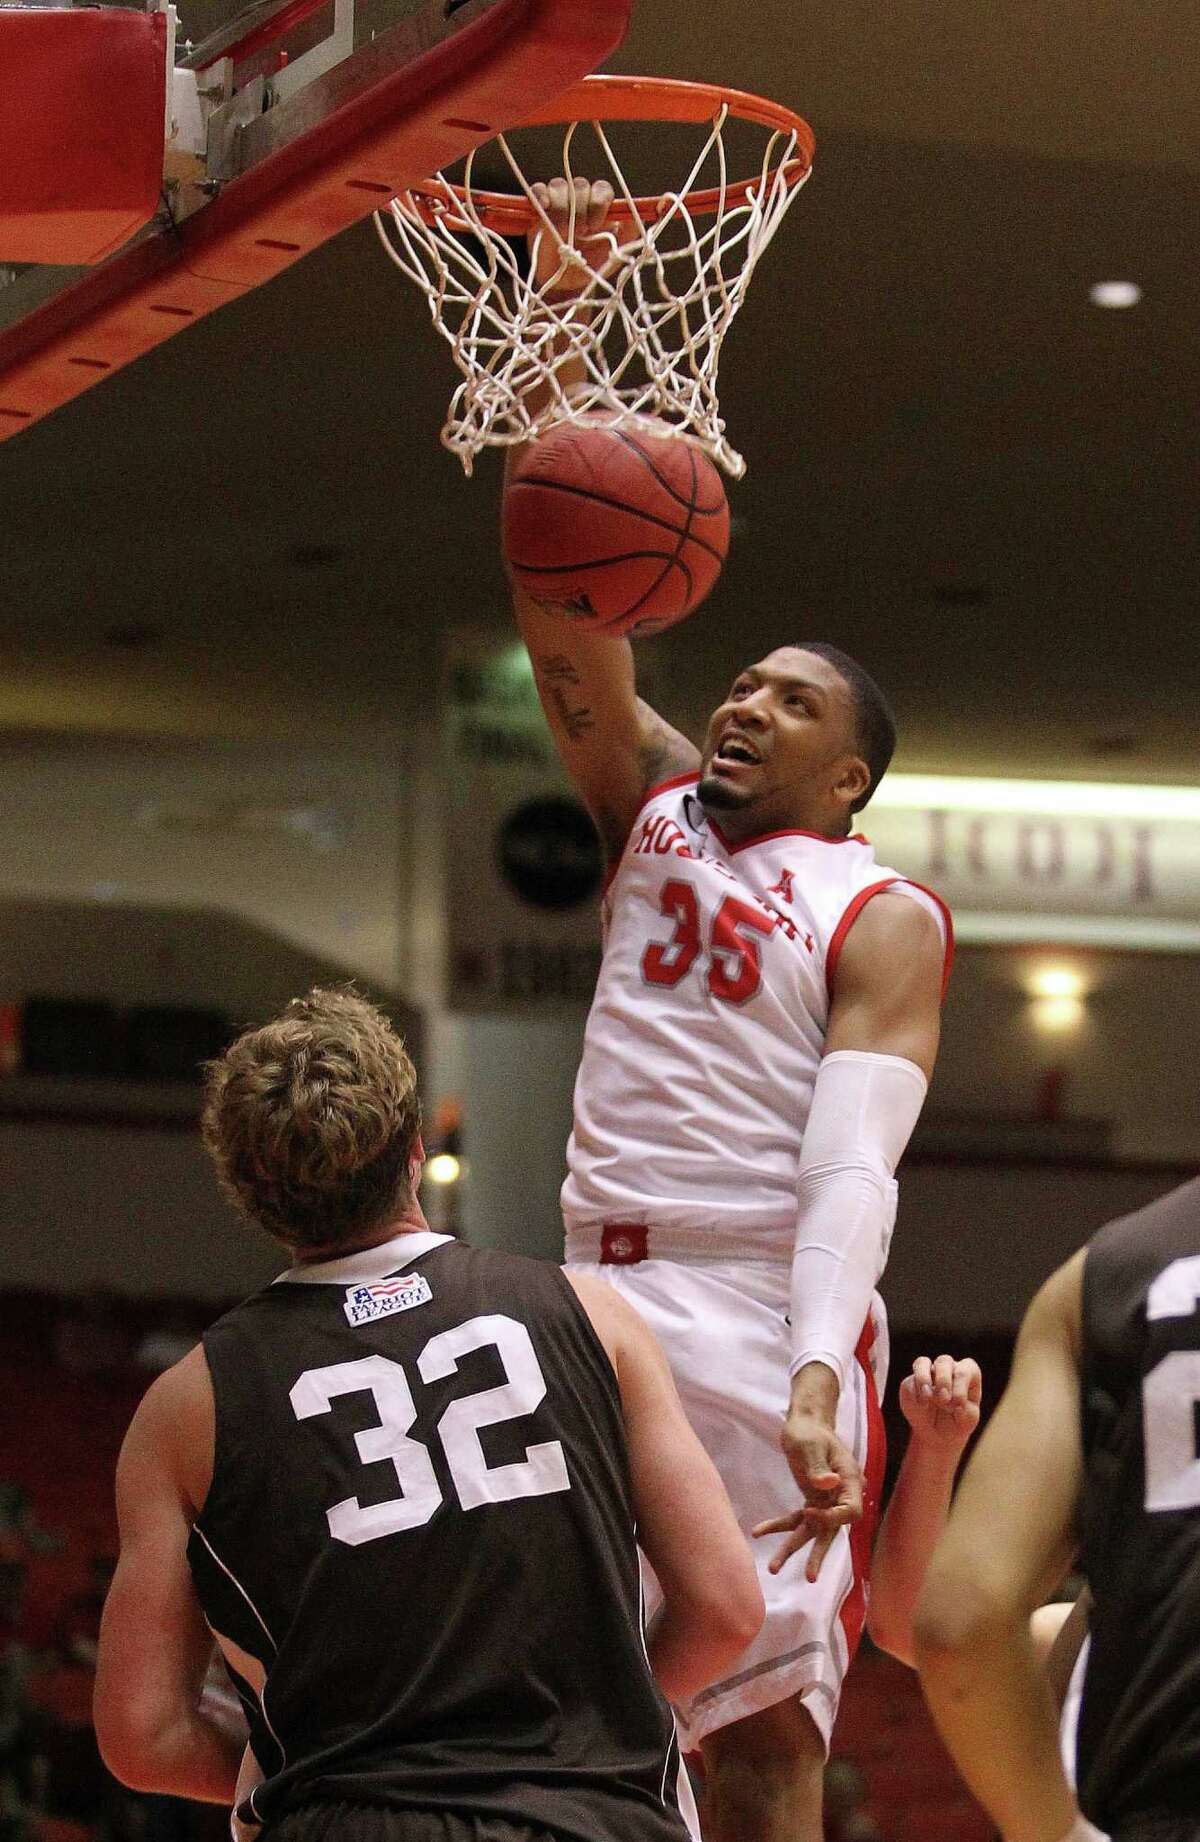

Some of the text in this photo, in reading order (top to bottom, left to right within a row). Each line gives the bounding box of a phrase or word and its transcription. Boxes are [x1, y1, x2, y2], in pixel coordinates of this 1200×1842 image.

[641, 879, 776, 1006] 35
[351, 1287, 422, 1315] PATRIOT
[289, 1314, 571, 1546] 32
